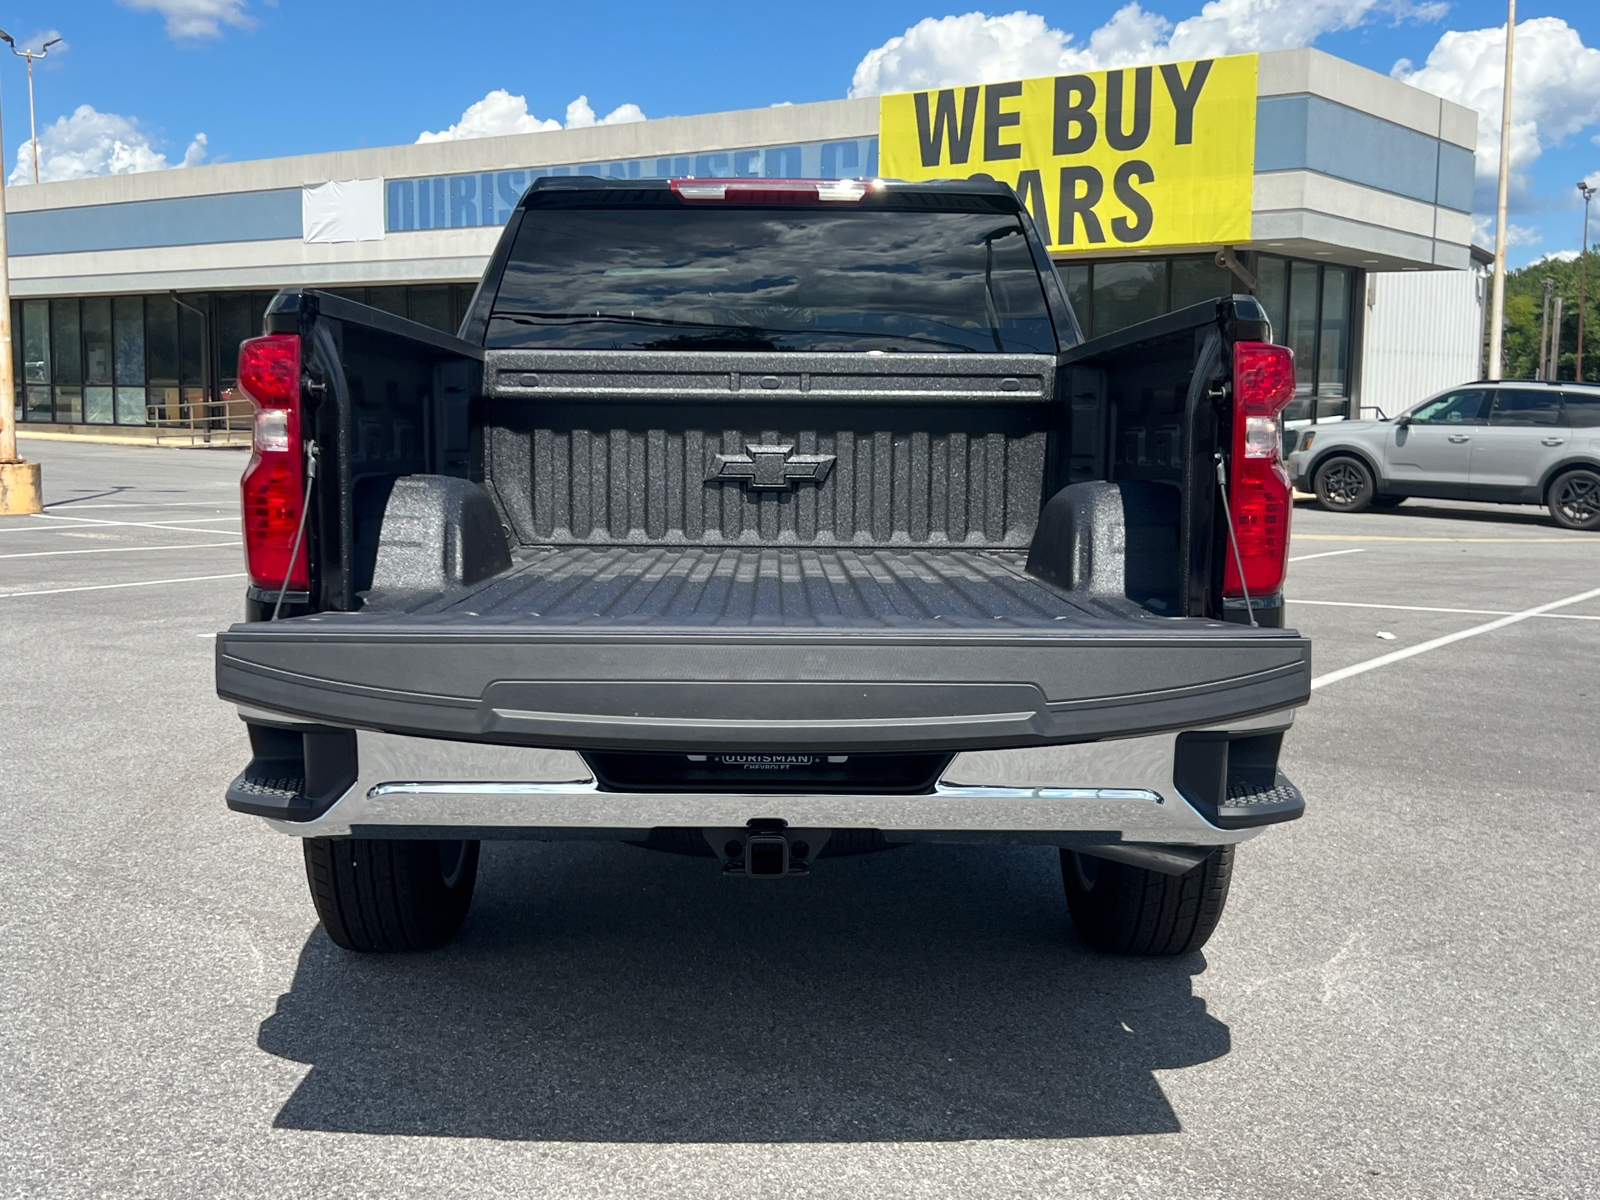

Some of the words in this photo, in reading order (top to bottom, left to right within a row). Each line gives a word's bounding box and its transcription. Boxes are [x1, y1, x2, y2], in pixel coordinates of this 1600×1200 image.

[914, 81, 1023, 167] WE
[1053, 59, 1215, 157] BUY
[968, 159, 1155, 246] ARS
